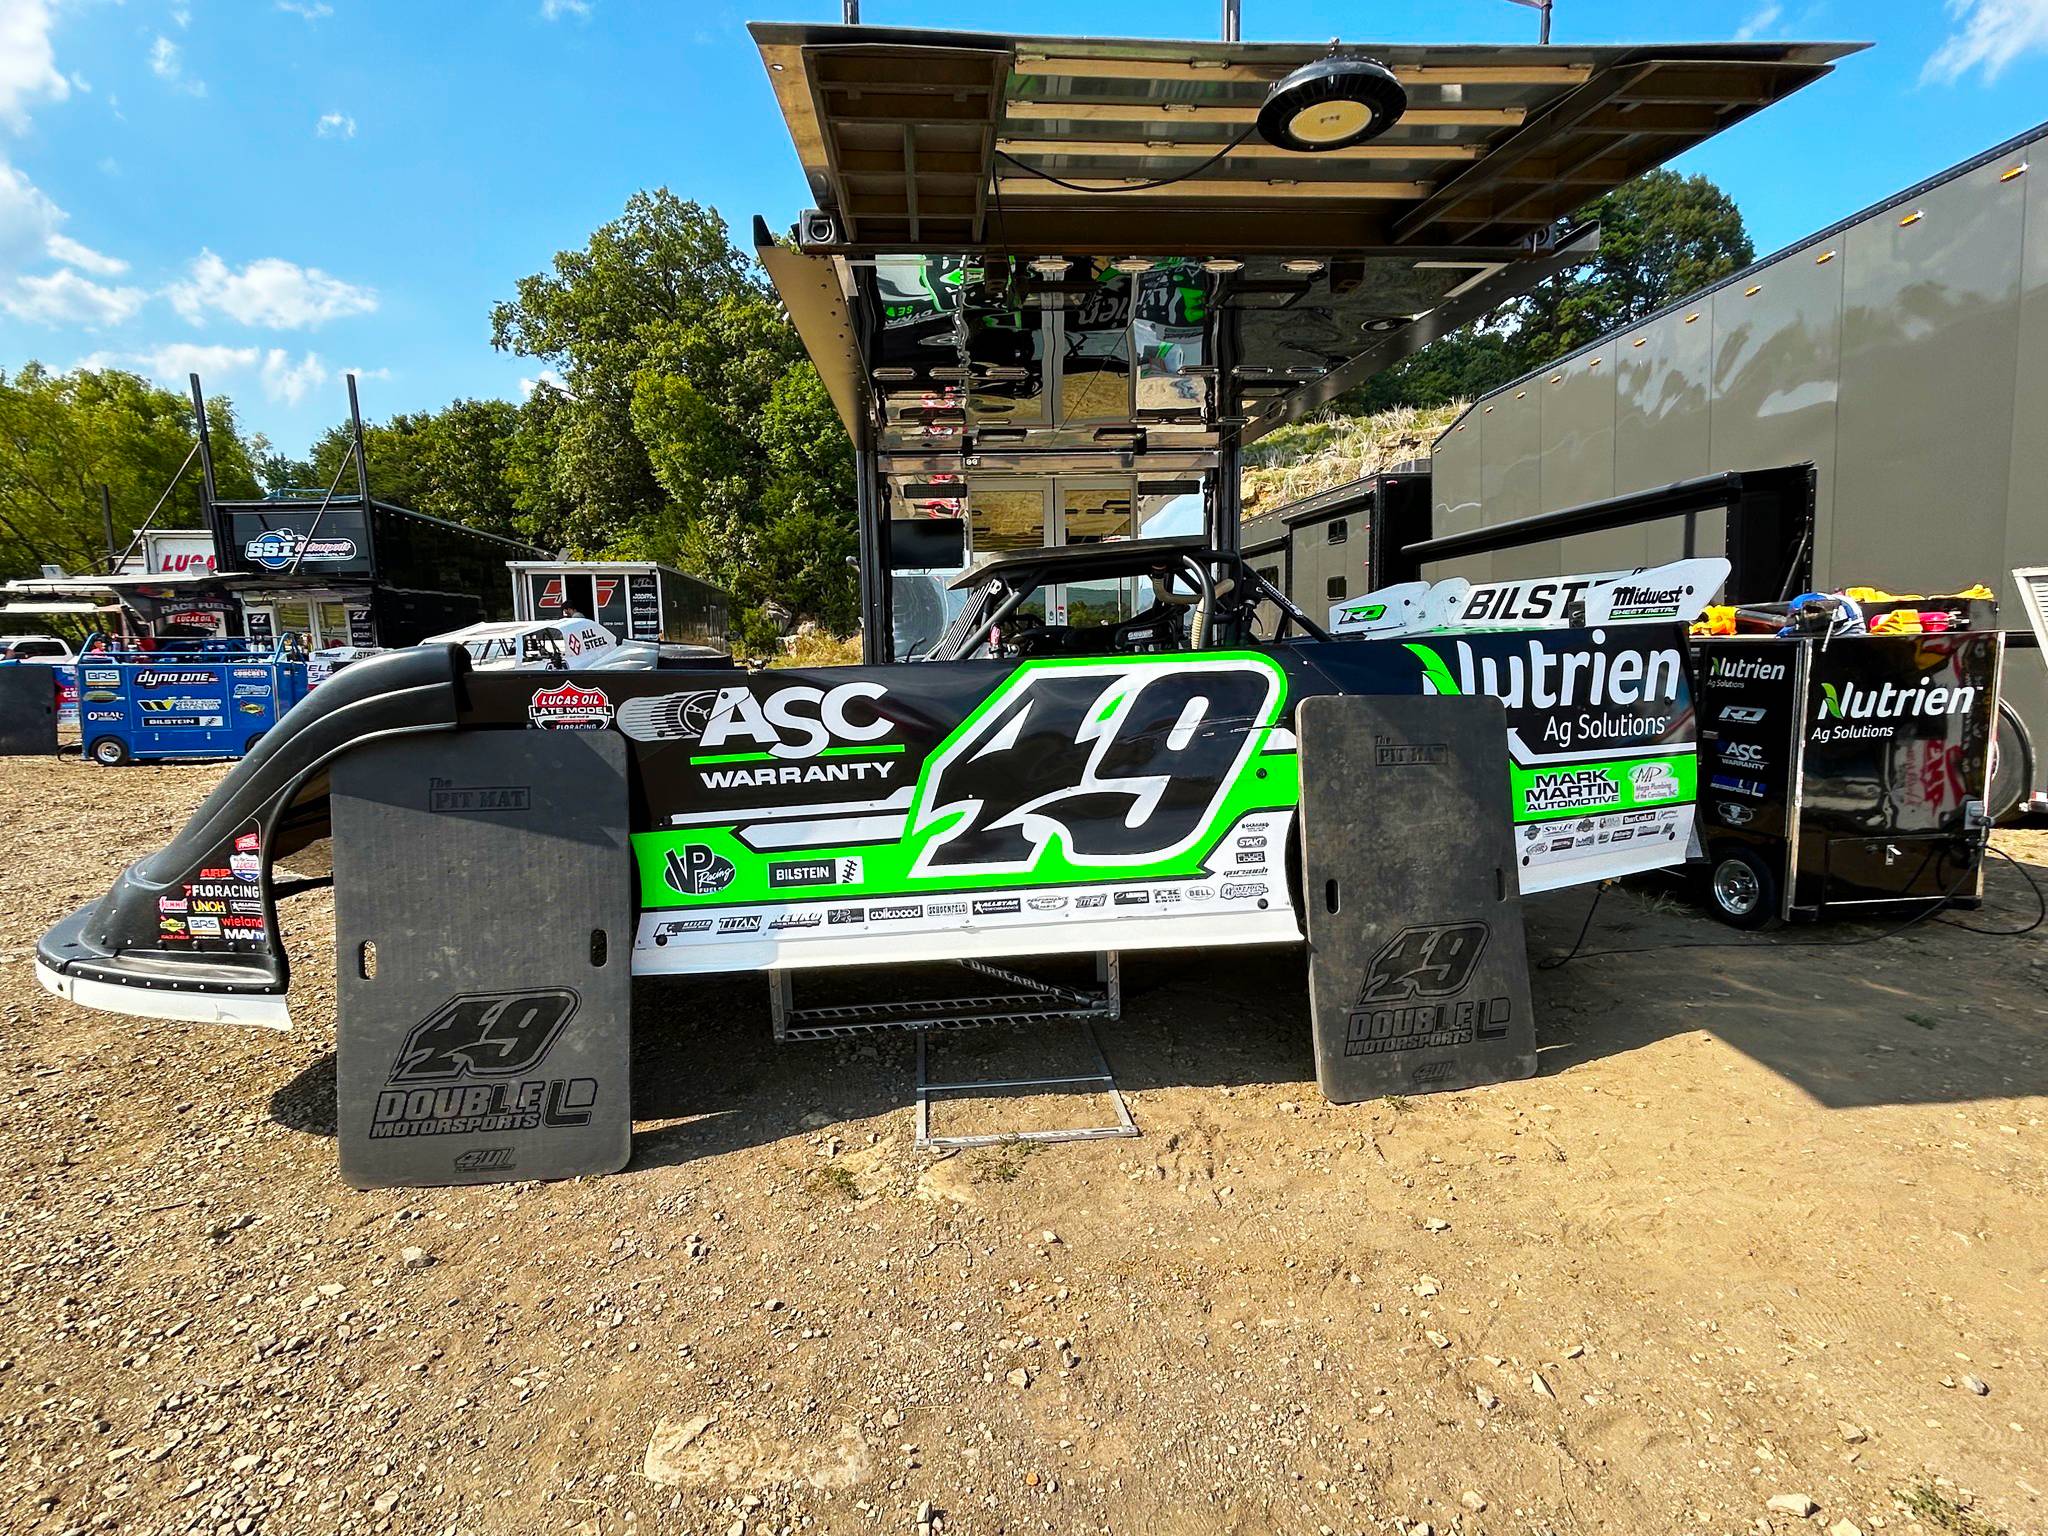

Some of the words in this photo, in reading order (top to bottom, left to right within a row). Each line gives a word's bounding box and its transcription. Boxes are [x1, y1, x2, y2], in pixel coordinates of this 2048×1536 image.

[248, 541, 295, 557] SSI
[295, 542, 351, 552] Mtorsports
[162, 554, 216, 572] LUCA
[1461, 579, 1617, 621] BILST
[1612, 586, 1683, 606] Midwest
[160, 603, 194, 614] RACE
[251, 615, 266, 624] 21
[582, 628, 596, 640] ALL
[584, 636, 607, 650] STEEL
[87, 672, 118, 680] BRS
[1709, 656, 1786, 680] Nutrien
[137, 670, 179, 686] dyno
[541, 695, 579, 705] LUCAS
[581, 694, 600, 705] OIL
[1816, 676, 1976, 720] Nutrien
[532, 707, 564, 716] LATE
[566, 706, 611, 715] MODEL
[699, 682, 895, 759] ASC
[1544, 716, 1572, 747] Ag
[1577, 712, 1666, 739] Solutions
[1811, 727, 1831, 743] Ag
[1832, 725, 1894, 741] Solutions
[1725, 742, 1763, 761] ASC
[905, 655, 1284, 878] 49
[1722, 758, 1765, 770] WARRANTY
[700, 761, 895, 790] WARRANTY
[1535, 768, 1610, 789] MARK
[479, 790, 526, 808] MAT
[1525, 781, 1619, 805] MARTIN
[1526, 794, 1620, 812] AUTOMOTIVE
[200, 868, 232, 877] ARP
[664, 843, 715, 895] VP
[698, 867, 735, 887] Racing
[775, 866, 830, 881] BILSTEIN
[192, 885, 259, 898] FLORACING
[191, 899, 227, 912] UNOH
[928, 903, 966, 914] SCHOENFELD
[981, 899, 1019, 907] ALLSTAR
[870, 905, 921, 920] wilwood
[221, 916, 263, 928] wieland
[719, 916, 761, 931] TITAN
[1354, 919, 1493, 1007] 49
[1348, 1002, 1475, 1040] DOUBLE
[387, 986, 580, 1084] 49
[1345, 1027, 1474, 1057] MOTORSPORTS
[375, 1081, 547, 1122] DOUBLE
[369, 1112, 542, 1139] MOTORSPORTS
